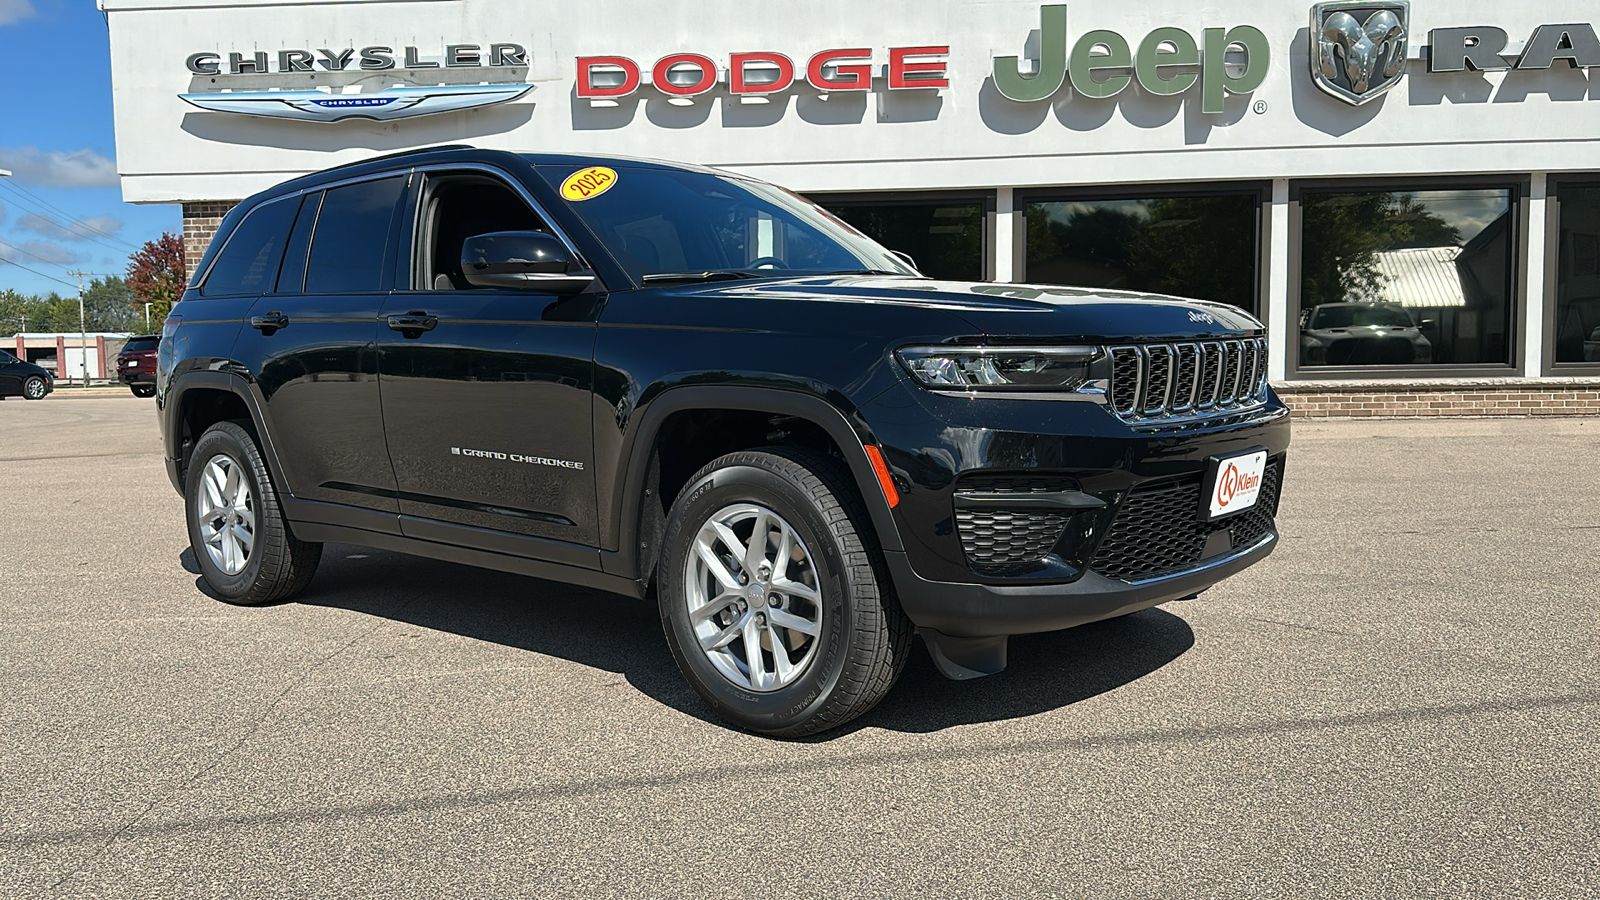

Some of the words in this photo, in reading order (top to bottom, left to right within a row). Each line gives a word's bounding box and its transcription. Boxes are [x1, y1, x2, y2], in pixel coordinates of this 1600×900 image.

[186, 43, 527, 75] CHRYSLER
[575, 45, 950, 98] DODGE
[993, 4, 1271, 114] Jeep
[320, 98, 388, 106] CHRYSLER
[570, 169, 610, 197] 2025
[462, 448, 507, 460] GRAND
[510, 454, 584, 470] CHEROKEE
[1237, 471, 1259, 492] Klein
[790, 690, 817, 715] PRIMACY
